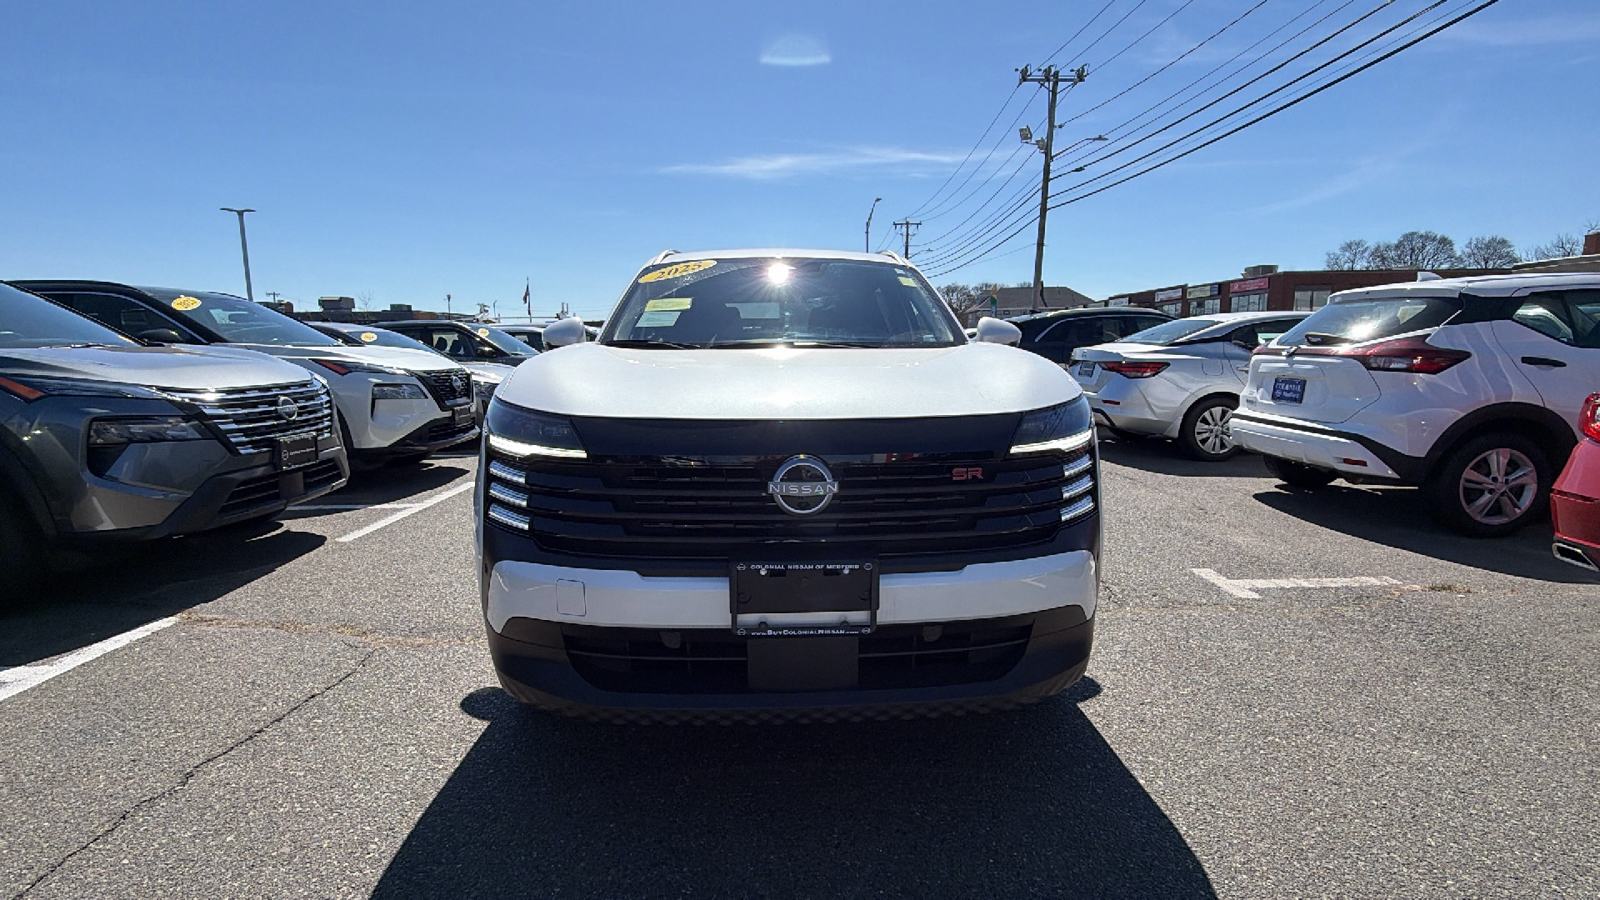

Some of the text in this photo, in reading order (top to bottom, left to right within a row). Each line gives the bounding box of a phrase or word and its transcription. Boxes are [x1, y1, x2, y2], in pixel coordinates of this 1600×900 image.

[655, 261, 704, 279] 2025
[951, 466, 984, 481] SR
[769, 482, 838, 494] NISSAN
